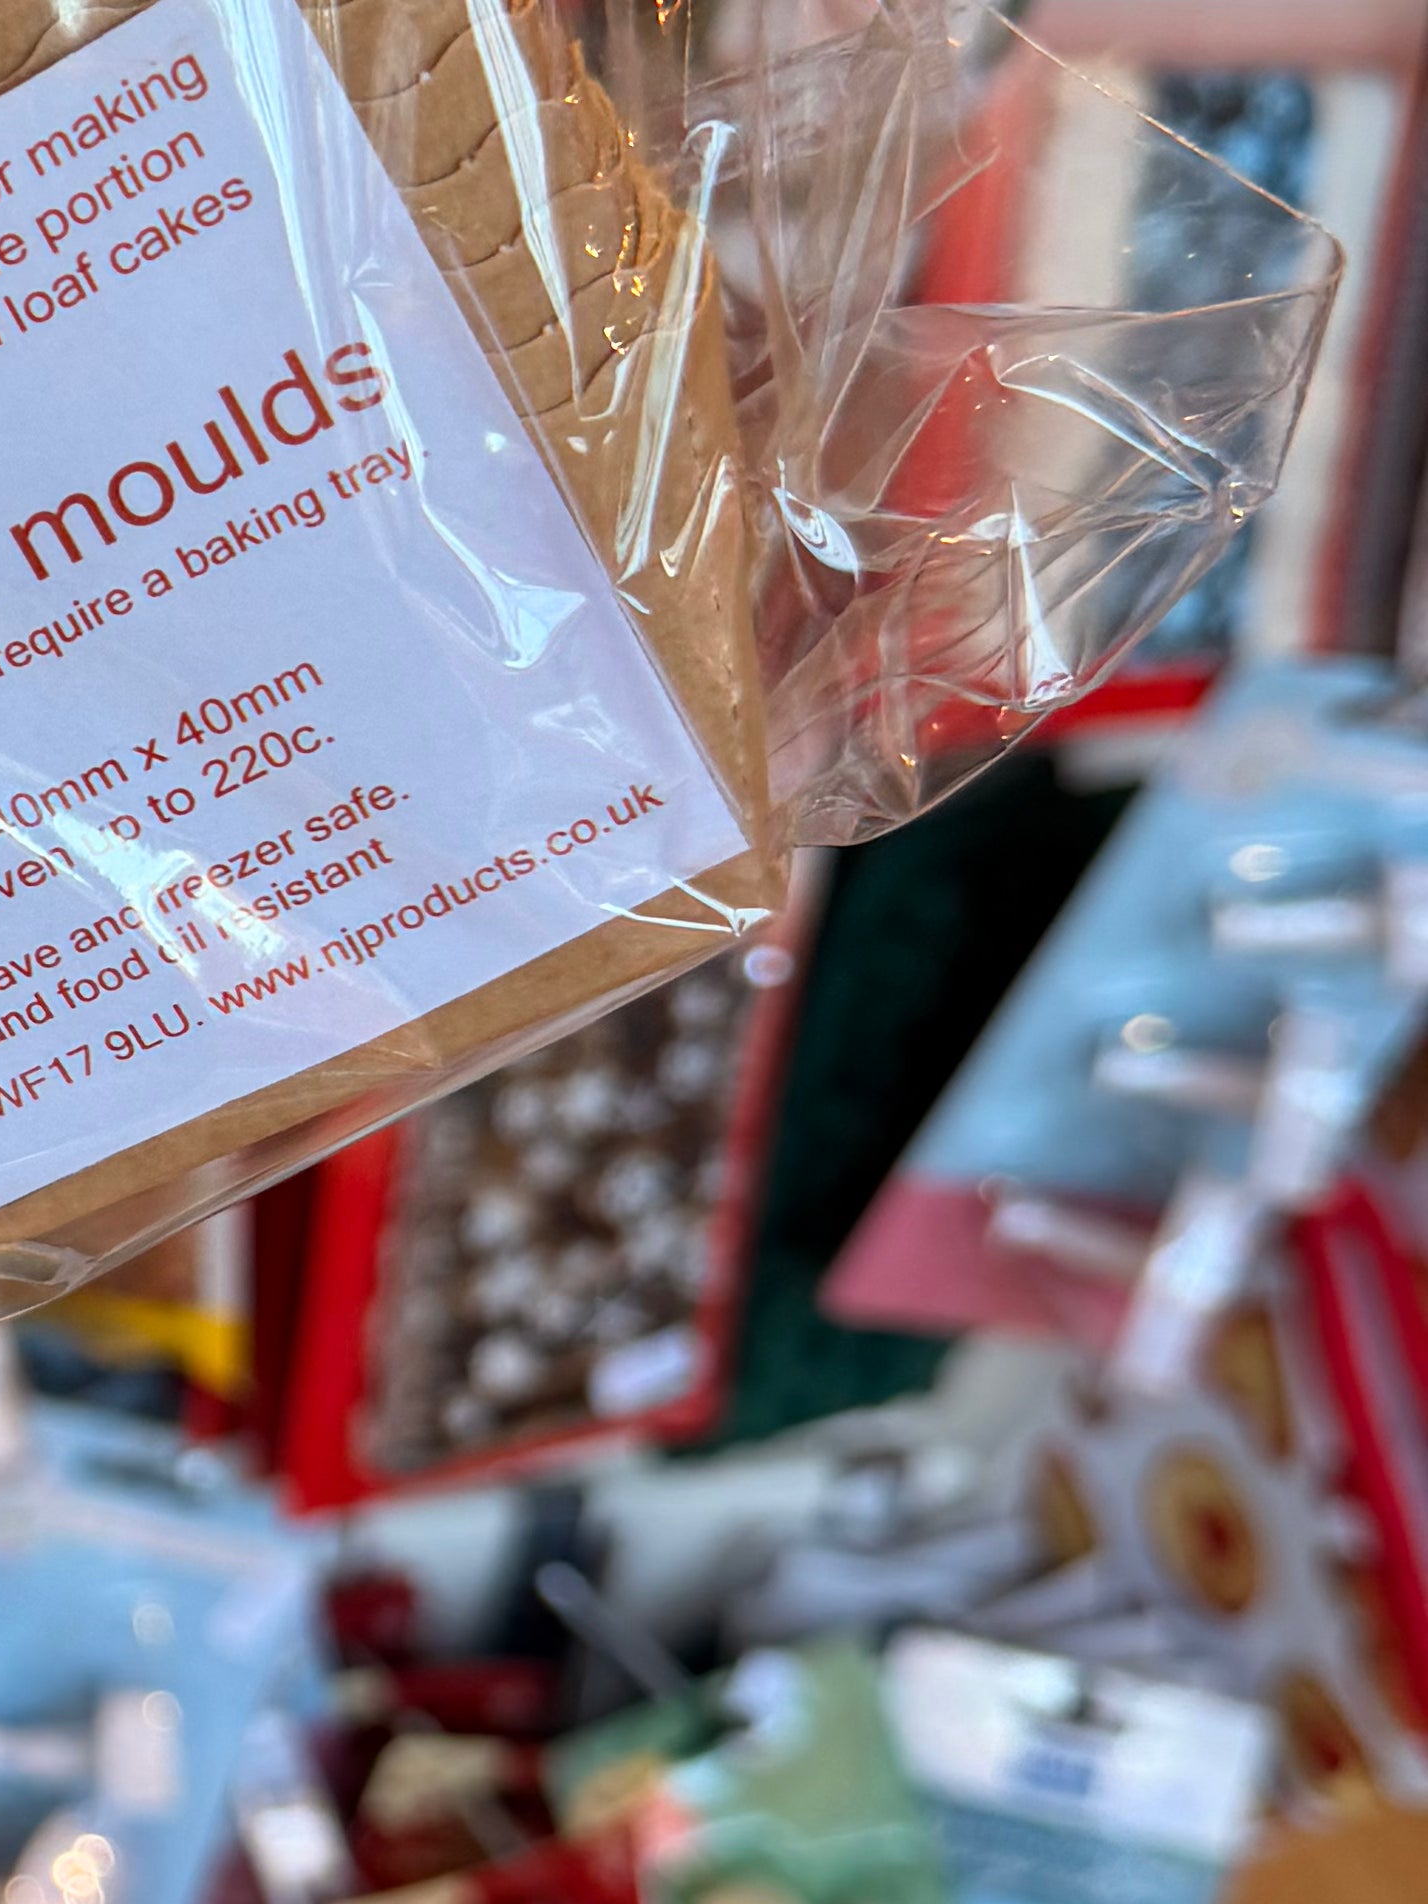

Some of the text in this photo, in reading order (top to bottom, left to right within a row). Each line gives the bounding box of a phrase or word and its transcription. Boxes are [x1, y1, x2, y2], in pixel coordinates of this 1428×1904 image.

[27, 54, 208, 176] making
[36, 131, 204, 255] portion
[3, 251, 99, 333] loaf
[109, 178, 253, 275] cakes
[10, 339, 391, 581] moulds
[142, 569, 173, 598] a
[175, 489, 326, 579] baking
[328, 439, 432, 500] tray.
[134, 739, 168, 771] x
[177, 663, 323, 745] 40mm
[147, 788, 196, 824] to
[202, 725, 333, 798] 220c.
[305, 783, 411, 843] safe.
[56, 947, 152, 1010] food
[103, 1003, 205, 1062] 9LU.
[207, 784, 665, 1016] www.njproducts.co.uk
